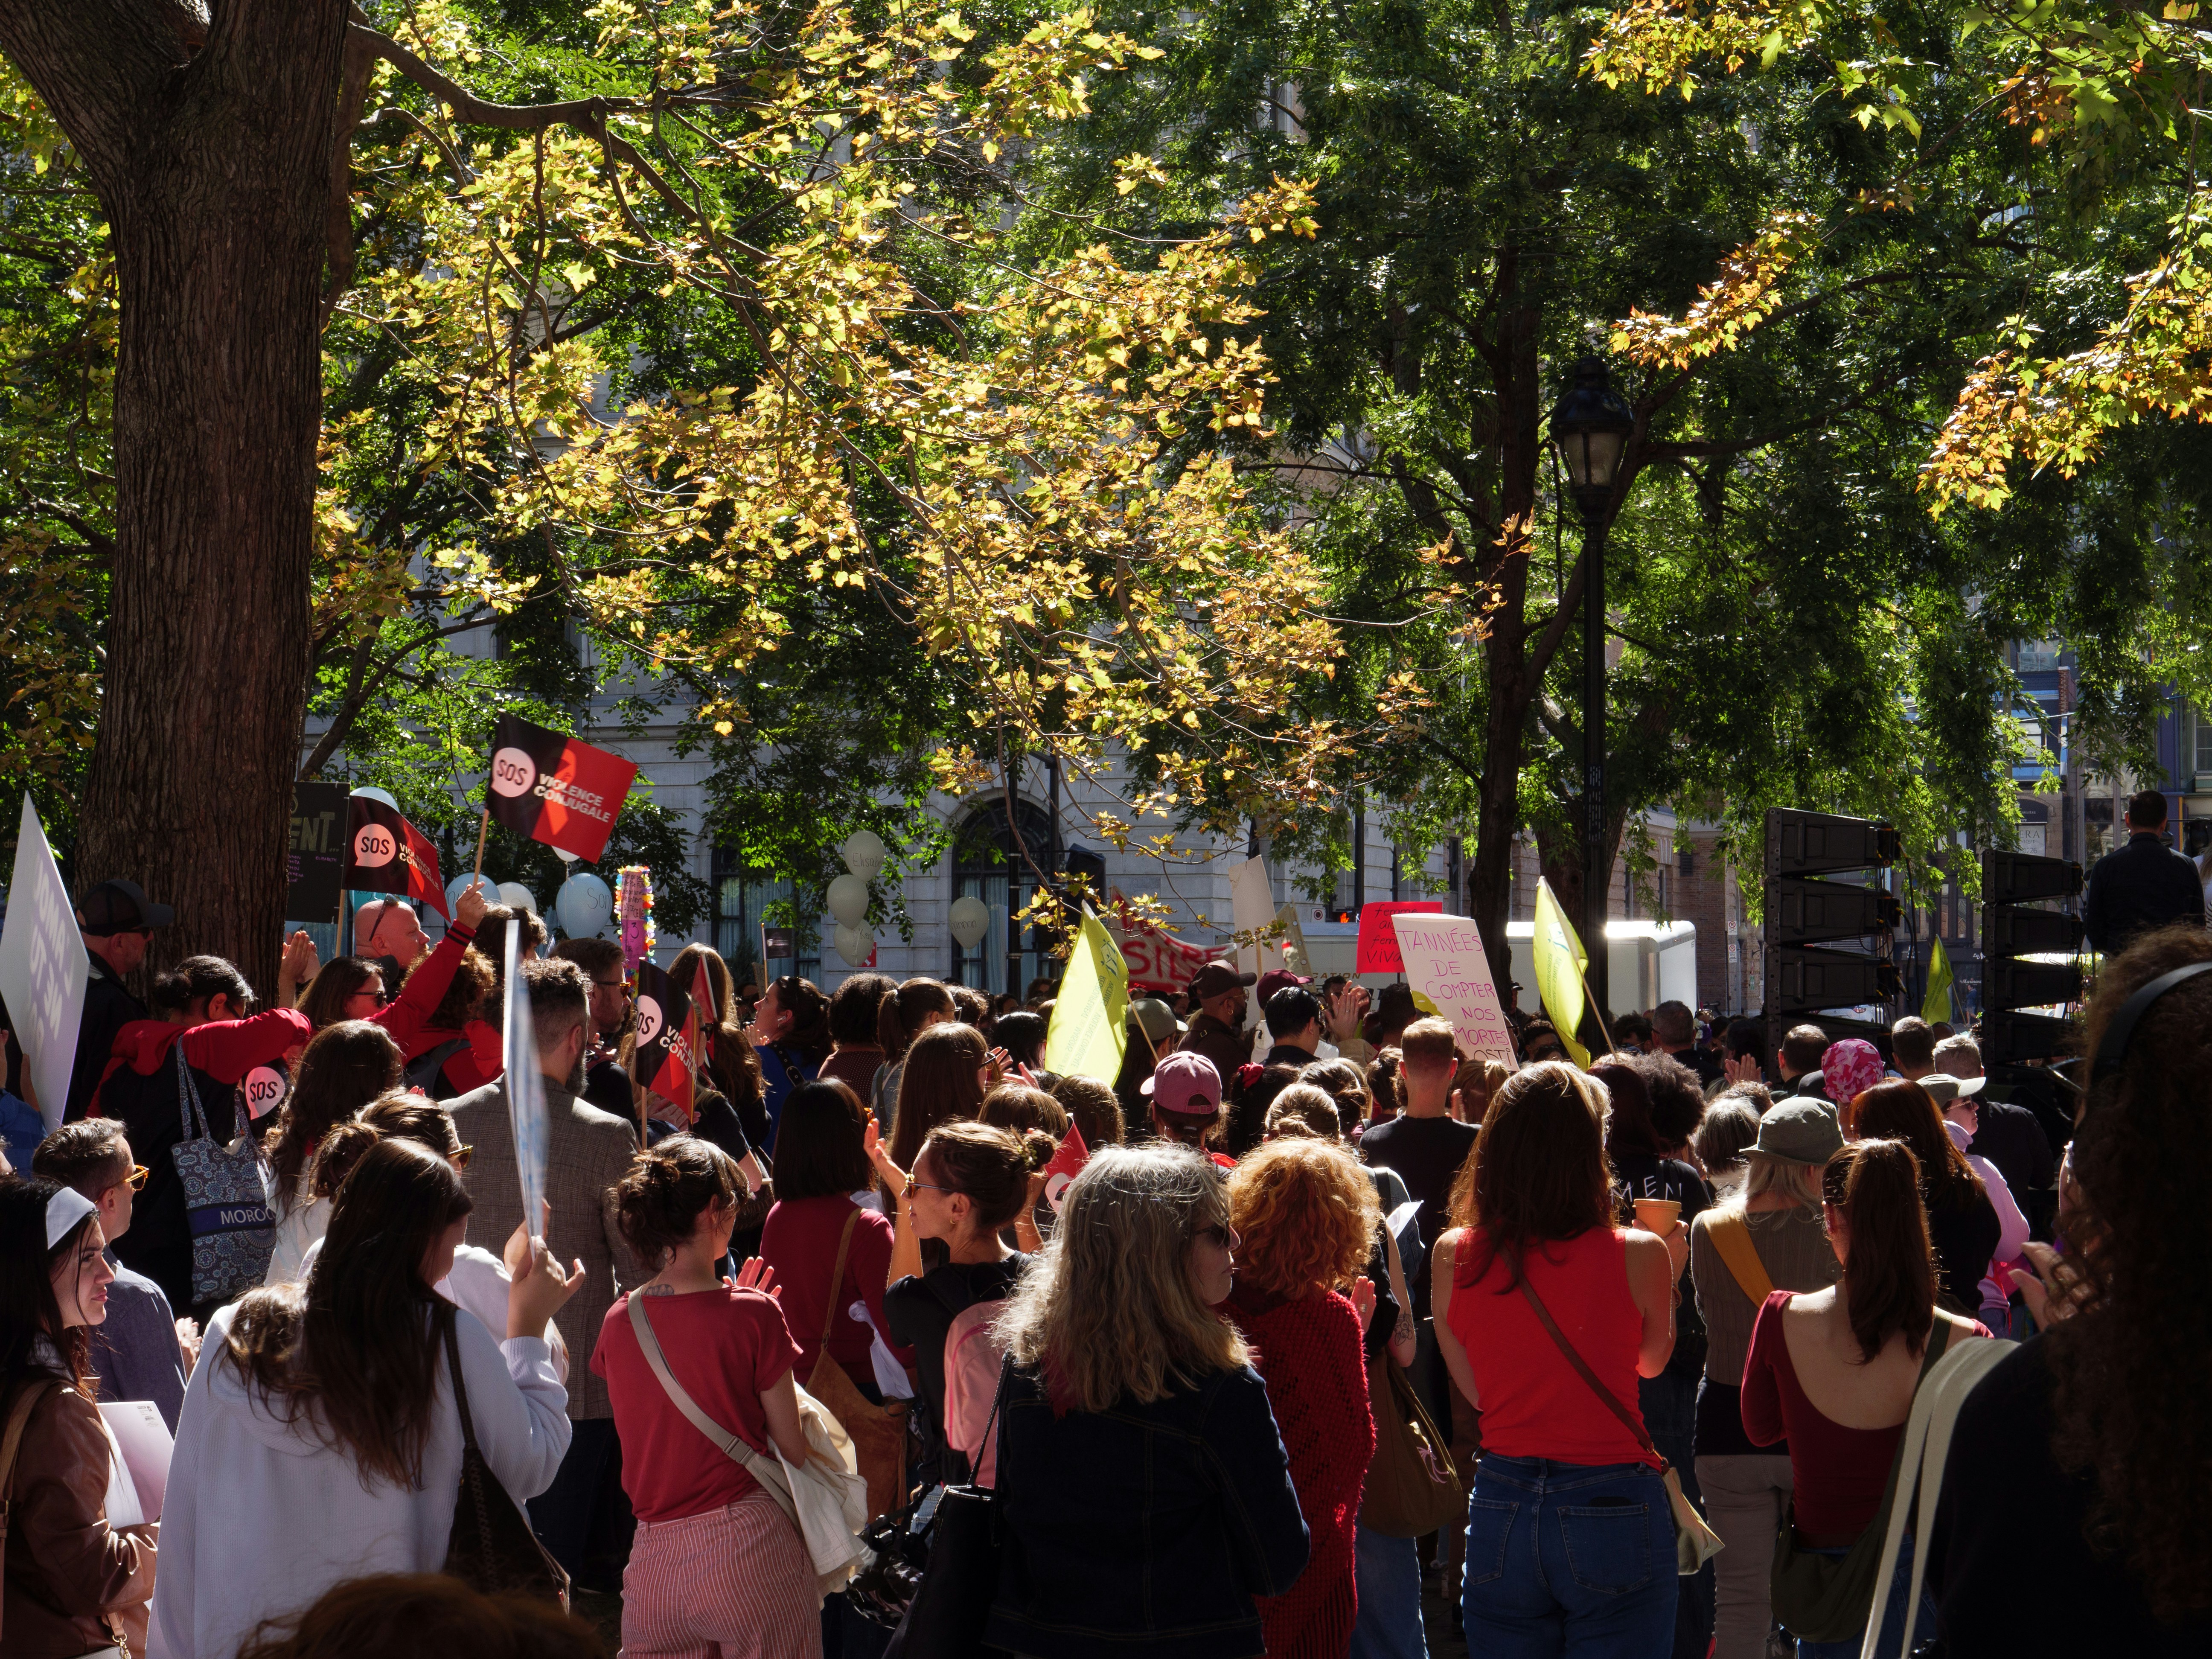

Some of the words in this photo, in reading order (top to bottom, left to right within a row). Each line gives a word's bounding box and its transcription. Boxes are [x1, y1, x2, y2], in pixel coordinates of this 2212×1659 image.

[497, 760, 527, 786] SOS
[539, 774, 604, 807] VIOLENCE
[533, 786, 611, 823] CONJUGALE
[361, 836, 390, 855] SOS
[399, 842, 432, 876] VIOLENCE
[399, 852, 440, 891] CONJUGALE
[1397, 928, 1482, 954] TANNÉES
[1430, 960, 1461, 977] DE
[1426, 981, 1496, 999] COMPTER
[1461, 1007, 1496, 1021] NOS
[1453, 1027, 1509, 1046] MORTES
[250, 1081, 278, 1102] SOS
